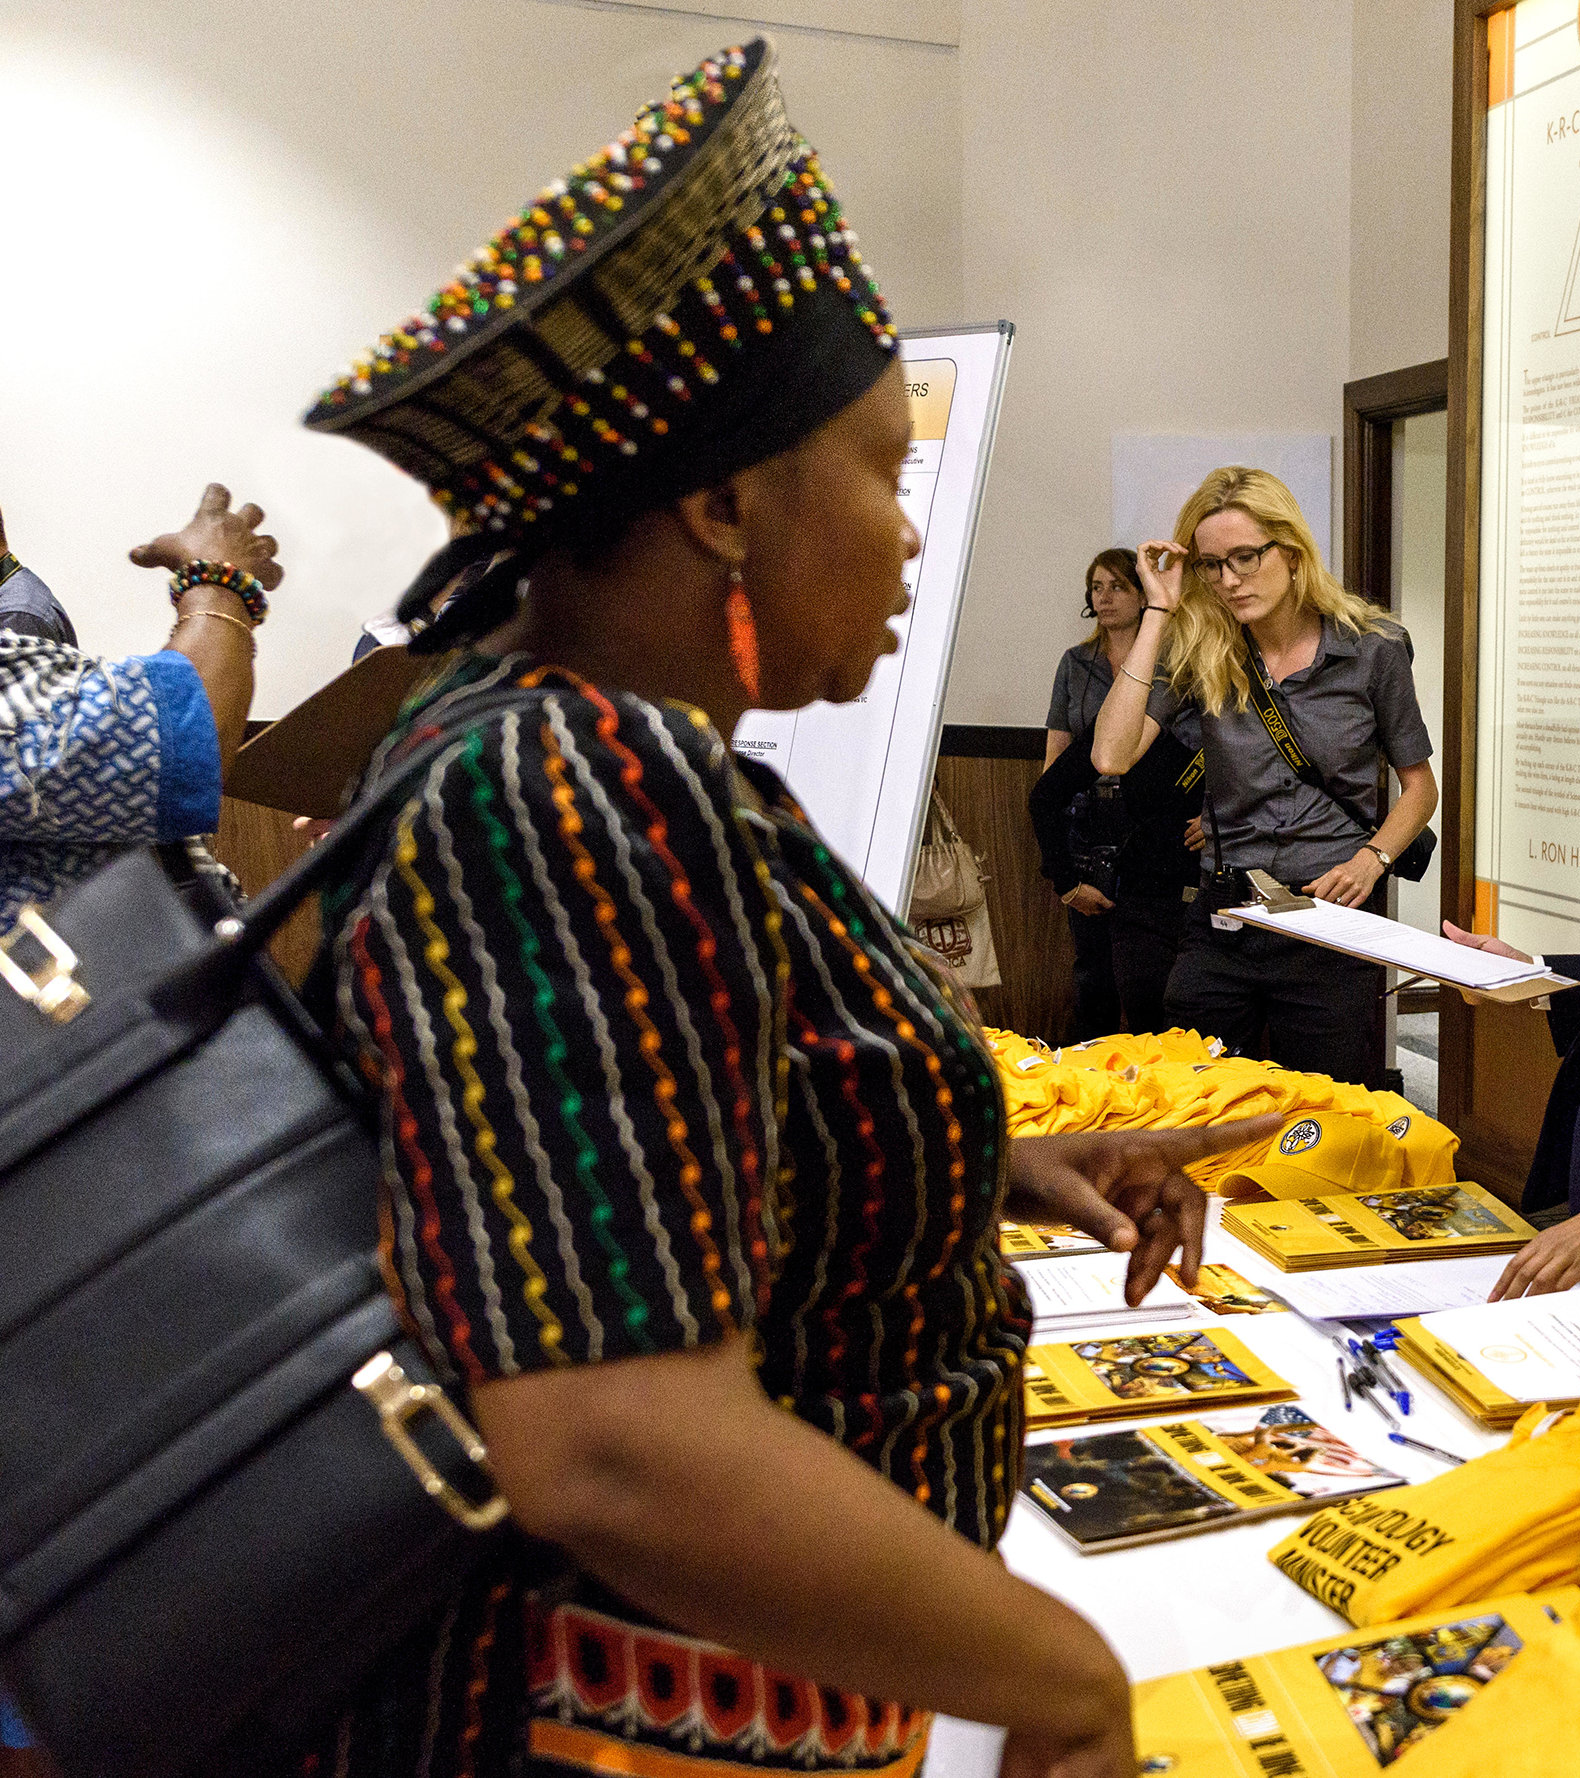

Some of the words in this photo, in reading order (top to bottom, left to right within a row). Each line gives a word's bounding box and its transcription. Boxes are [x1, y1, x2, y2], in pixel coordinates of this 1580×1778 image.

[1546, 109, 1580, 145] K-R-C
[1263, 707, 1288, 742] D500
[1284, 742, 1303, 767] Nikon
[1181, 768, 1198, 788] Nikon
[1529, 838, 1538, 859] L.
[1541, 840, 1566, 865] RON
